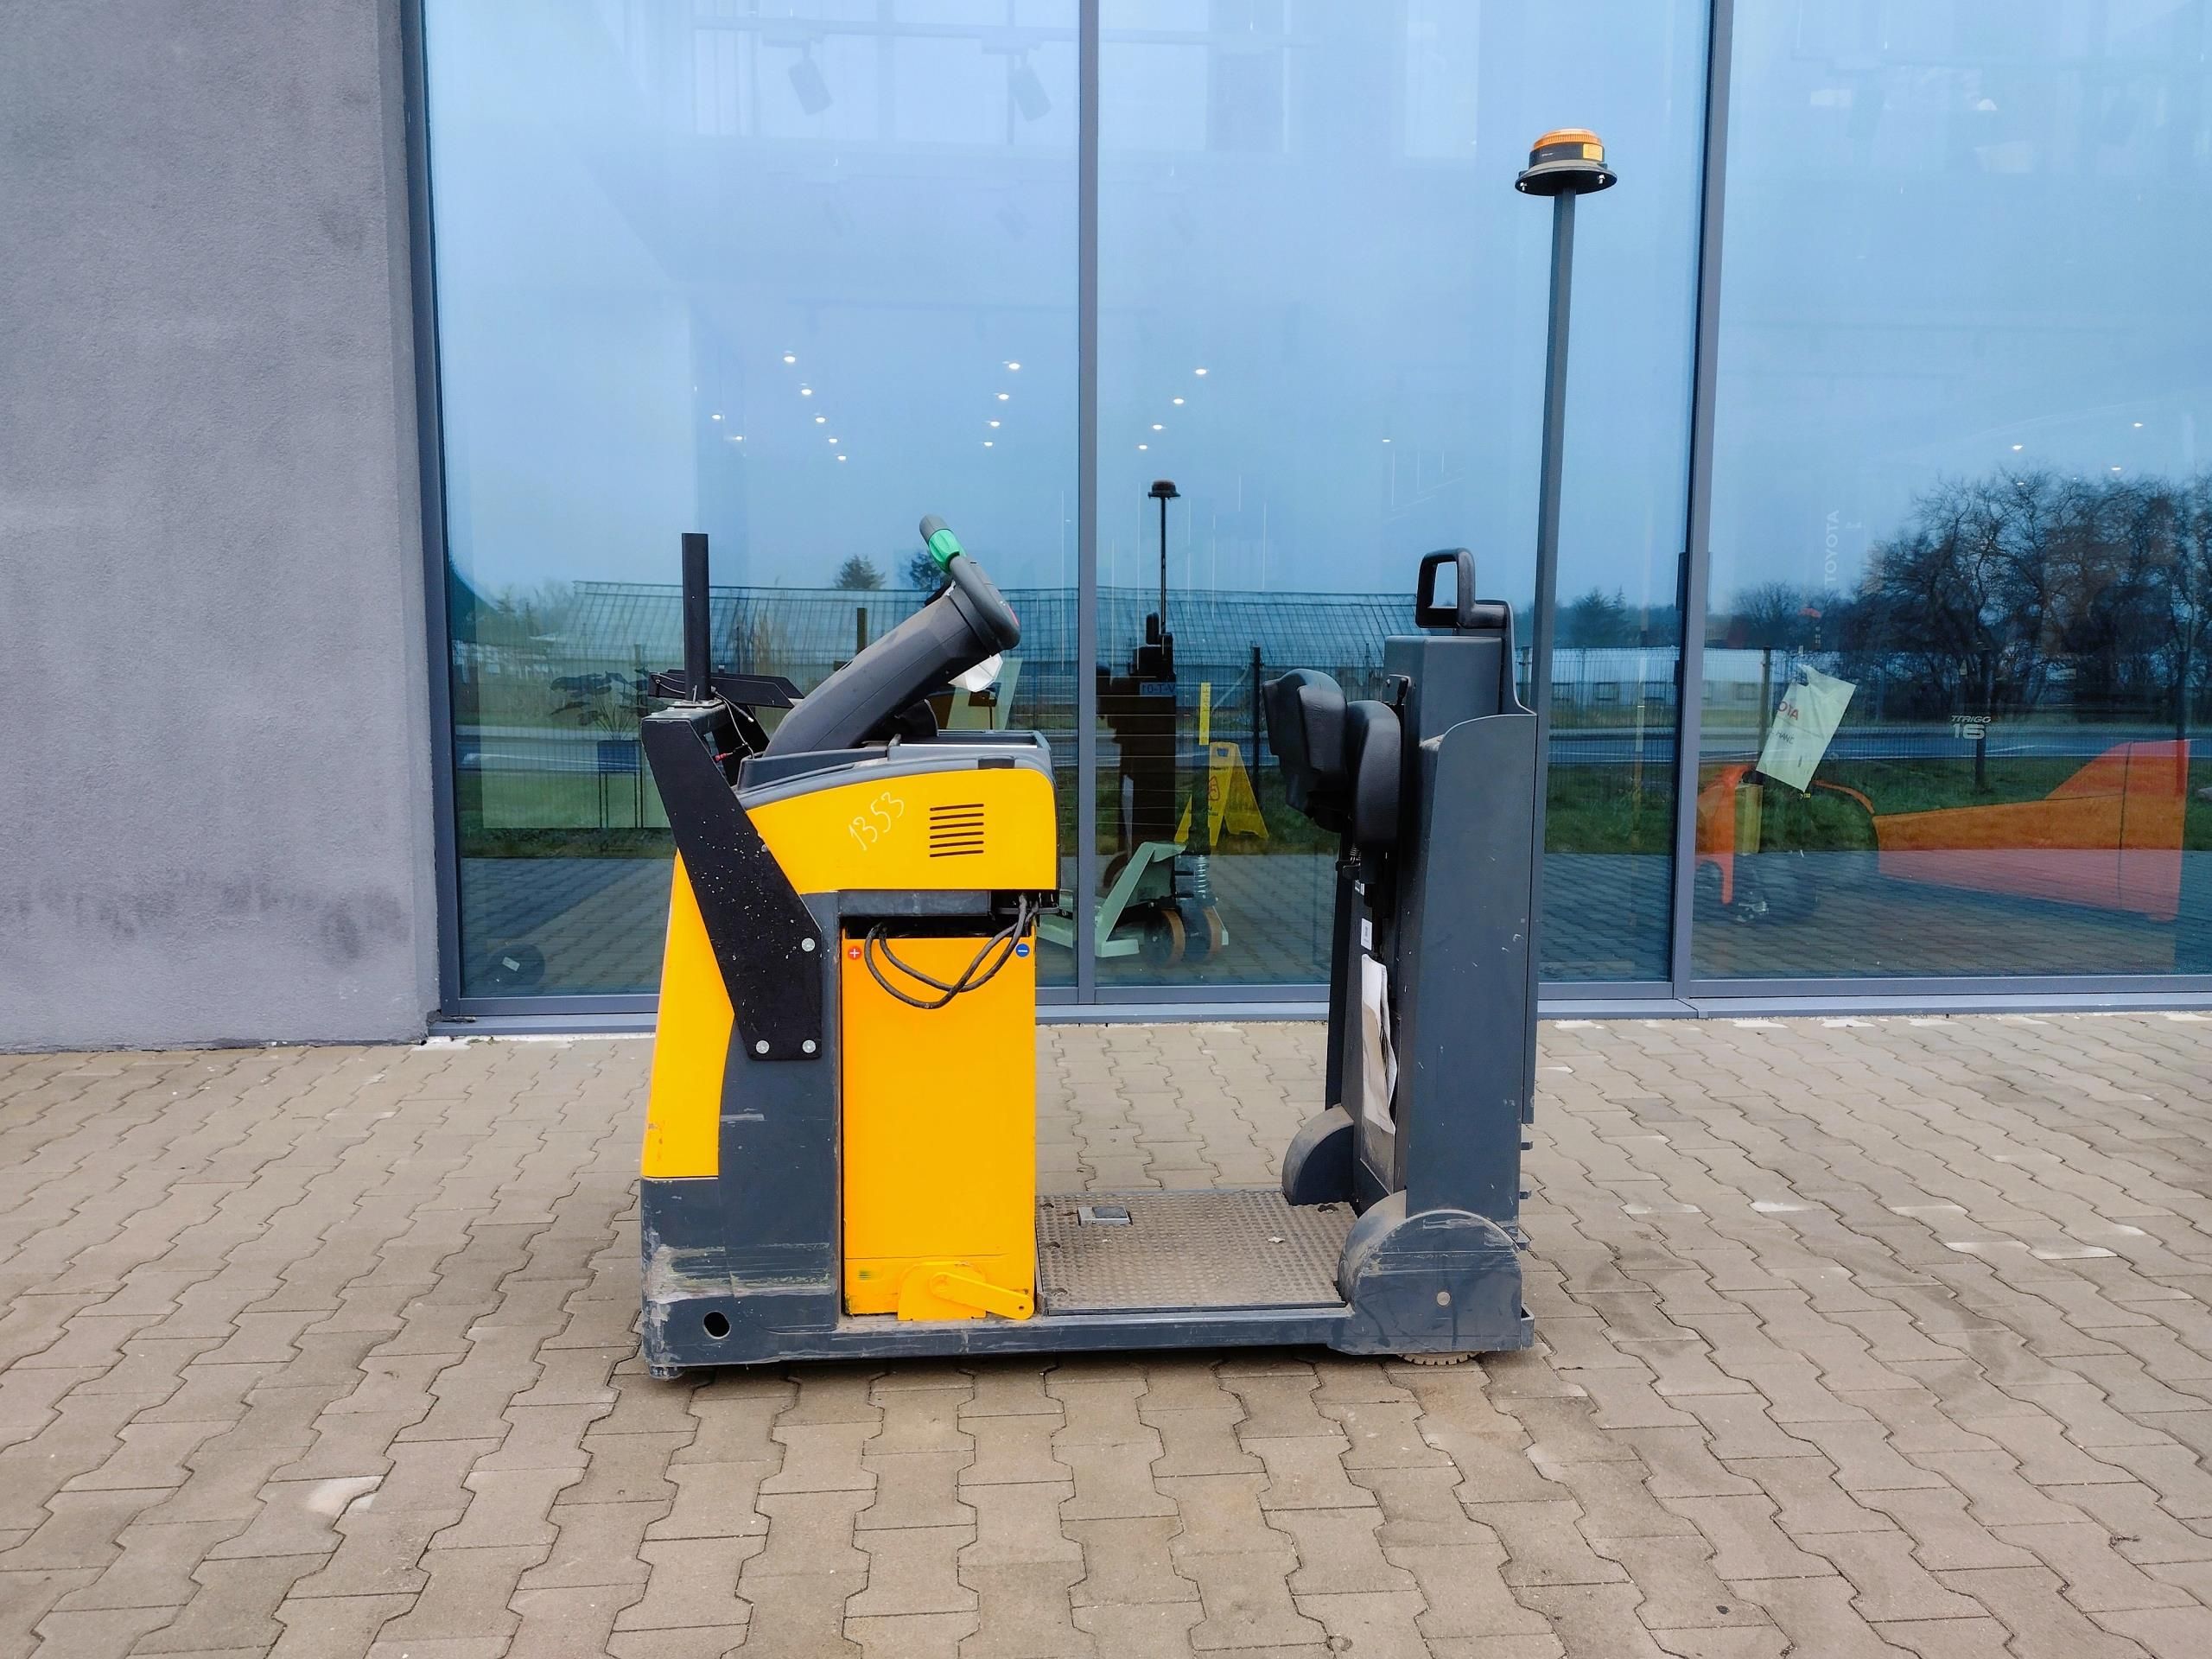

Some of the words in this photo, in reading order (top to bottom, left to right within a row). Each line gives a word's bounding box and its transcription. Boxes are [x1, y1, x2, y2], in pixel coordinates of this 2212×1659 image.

[1824, 509, 1840, 586] TOYOTA
[1953, 723, 1986, 740] 16
[849, 791, 905, 851] 1353
